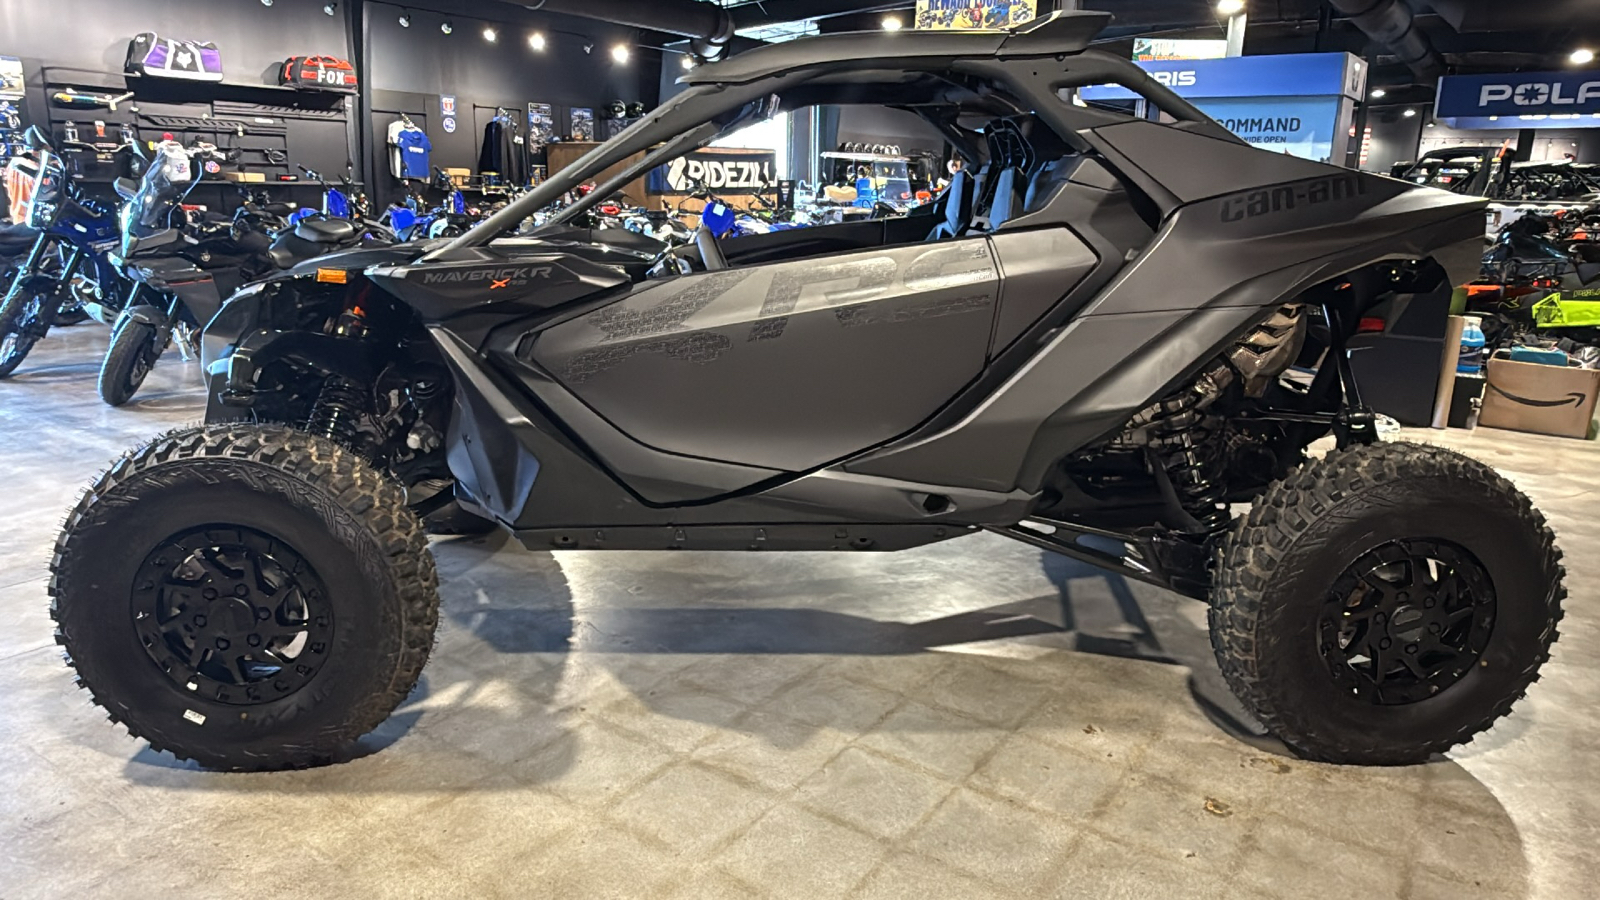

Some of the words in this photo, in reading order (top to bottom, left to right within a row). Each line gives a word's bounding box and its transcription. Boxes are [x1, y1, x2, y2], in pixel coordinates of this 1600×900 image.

[317, 69, 345, 86] FOX
[1263, 136, 1287, 144] OPEN
[423, 267, 529, 284] MAVERICK
[530, 266, 553, 279] R
